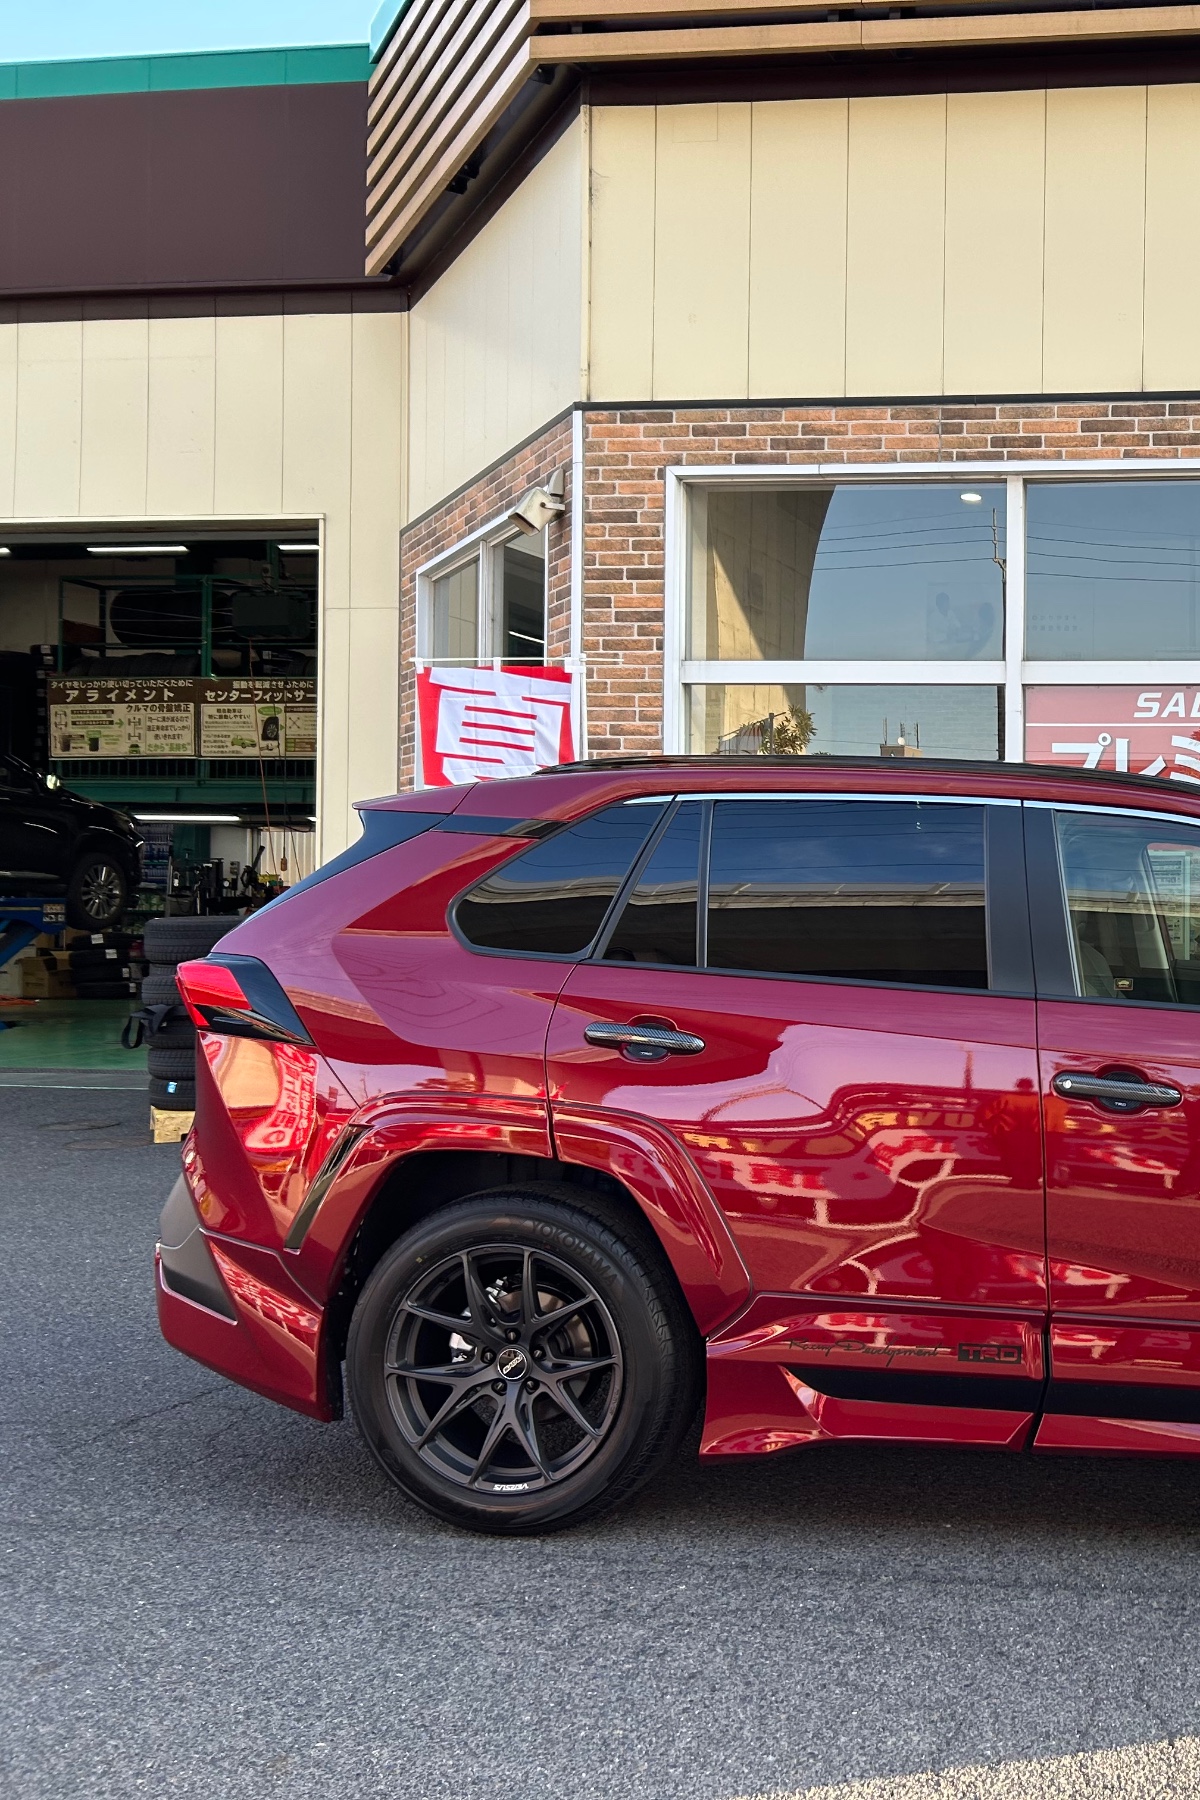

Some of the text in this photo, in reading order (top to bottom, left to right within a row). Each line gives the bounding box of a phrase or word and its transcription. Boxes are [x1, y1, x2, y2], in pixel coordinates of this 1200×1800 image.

[65, 689, 175, 702] アライメント
[533, 1219, 618, 1286] YOKOHAMA
